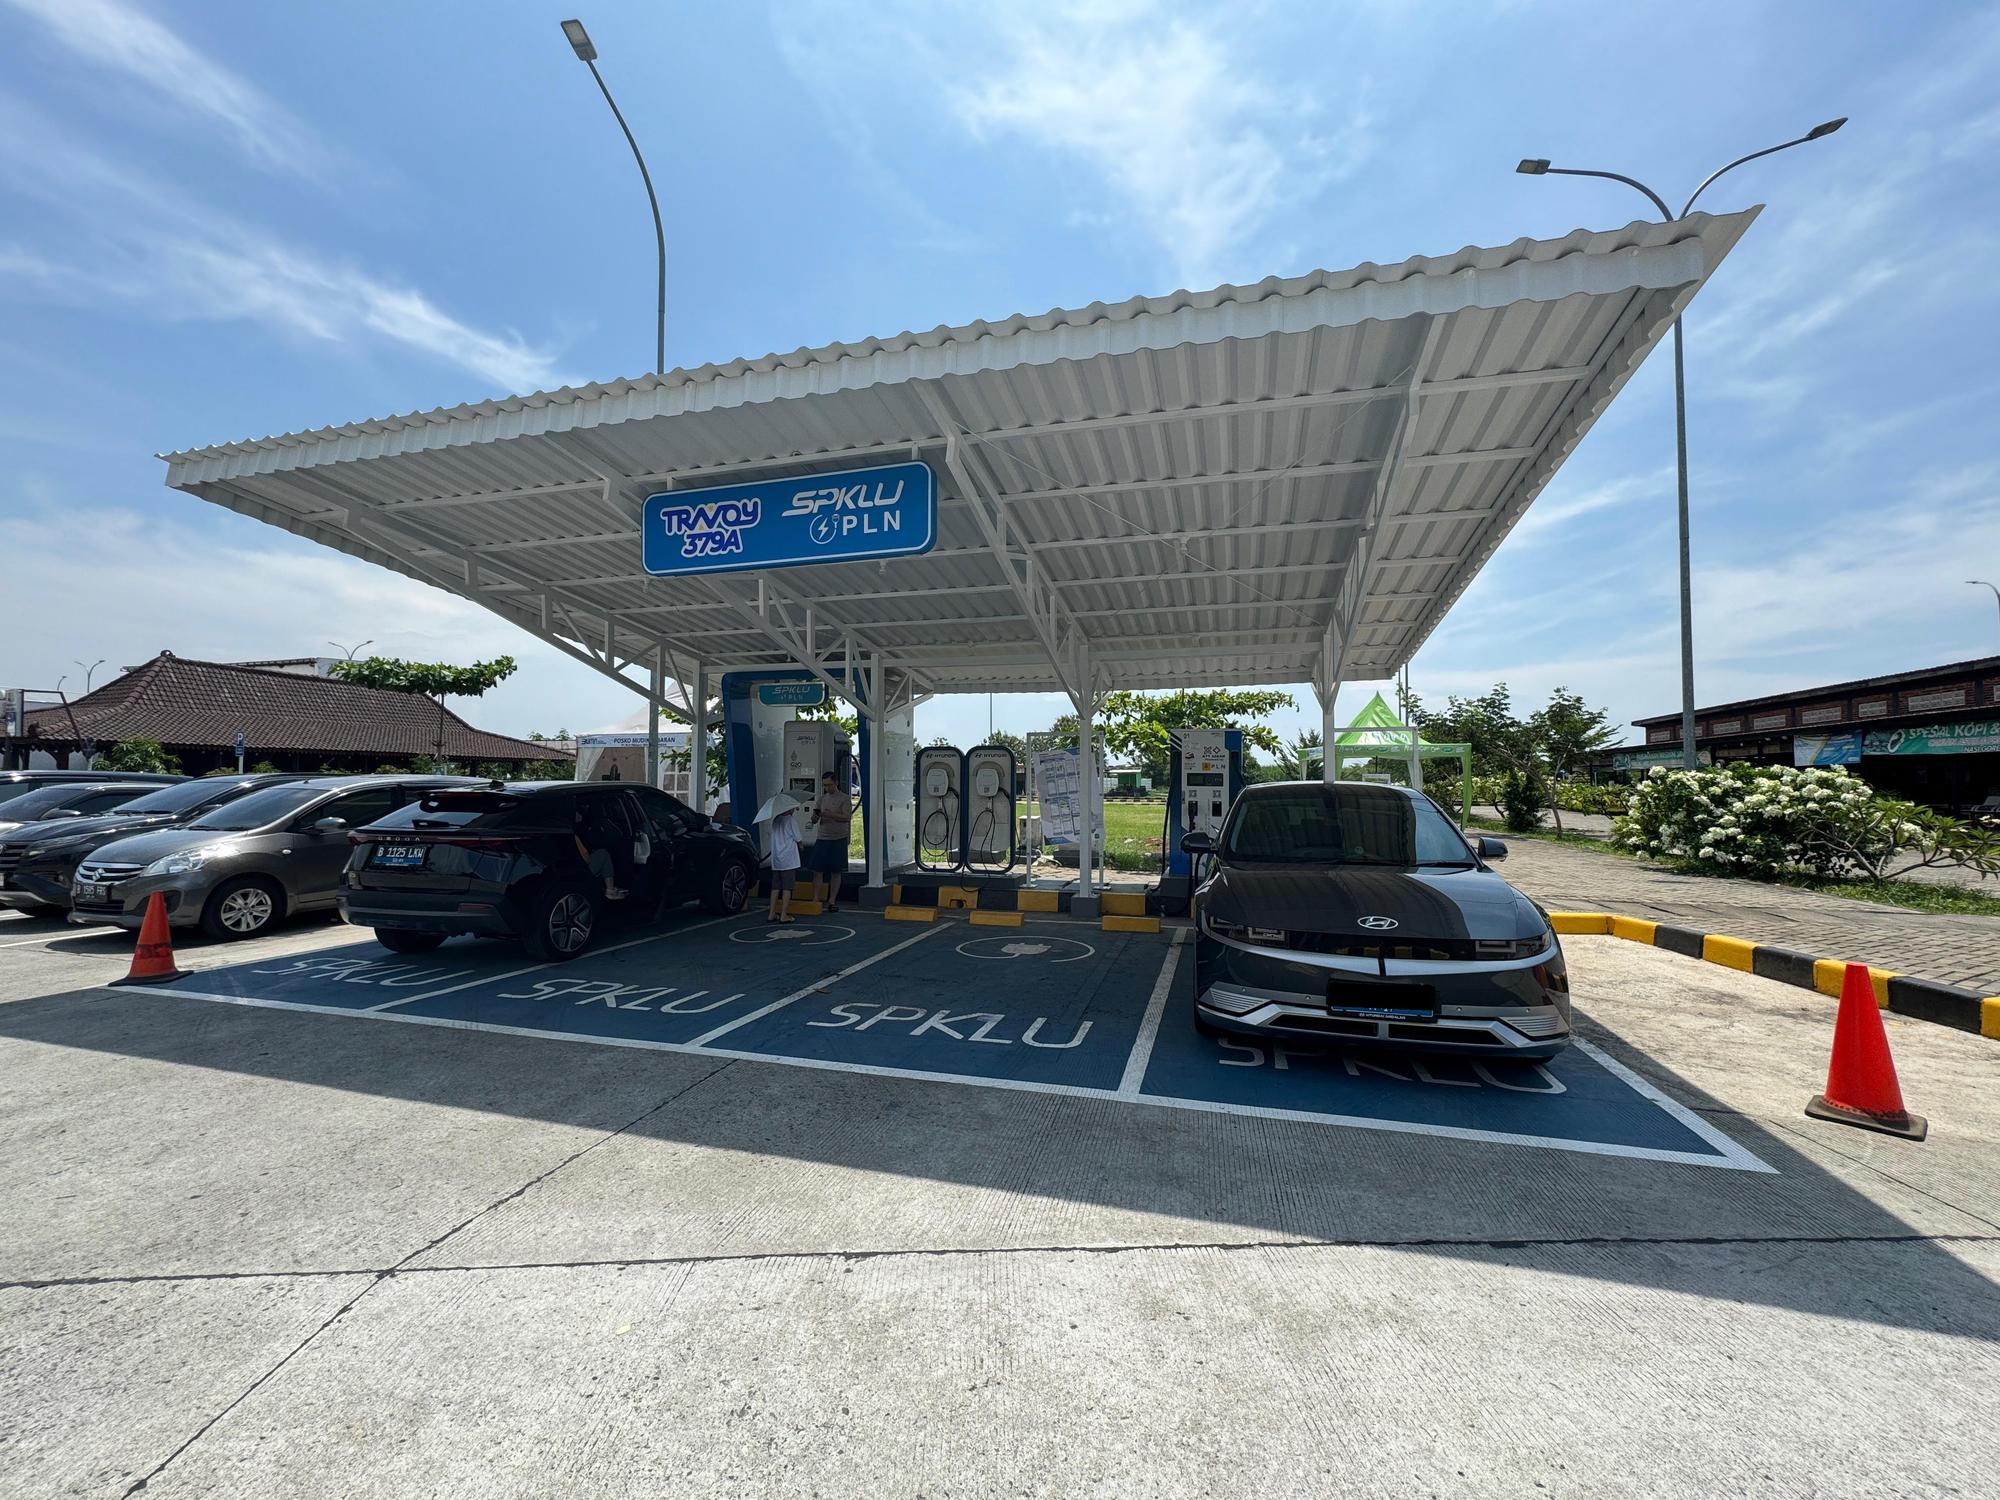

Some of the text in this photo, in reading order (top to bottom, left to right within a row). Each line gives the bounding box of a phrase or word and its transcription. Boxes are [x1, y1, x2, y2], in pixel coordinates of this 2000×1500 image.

[782, 479, 905, 517] SPKLU
[842, 510, 901, 536] PLN
[681, 528, 743, 557] 379A
[772, 686, 811, 694] SPKLU
[237, 732, 244, 745] P
[1954, 722, 1988, 737] KOPI
[377, 847, 385, 857] B
[386, 847, 407, 857] 1125
[250, 957, 475, 986] SPKLU
[496, 978, 746, 1014] SPKLU
[806, 1003, 1094, 1049] SPKLU
